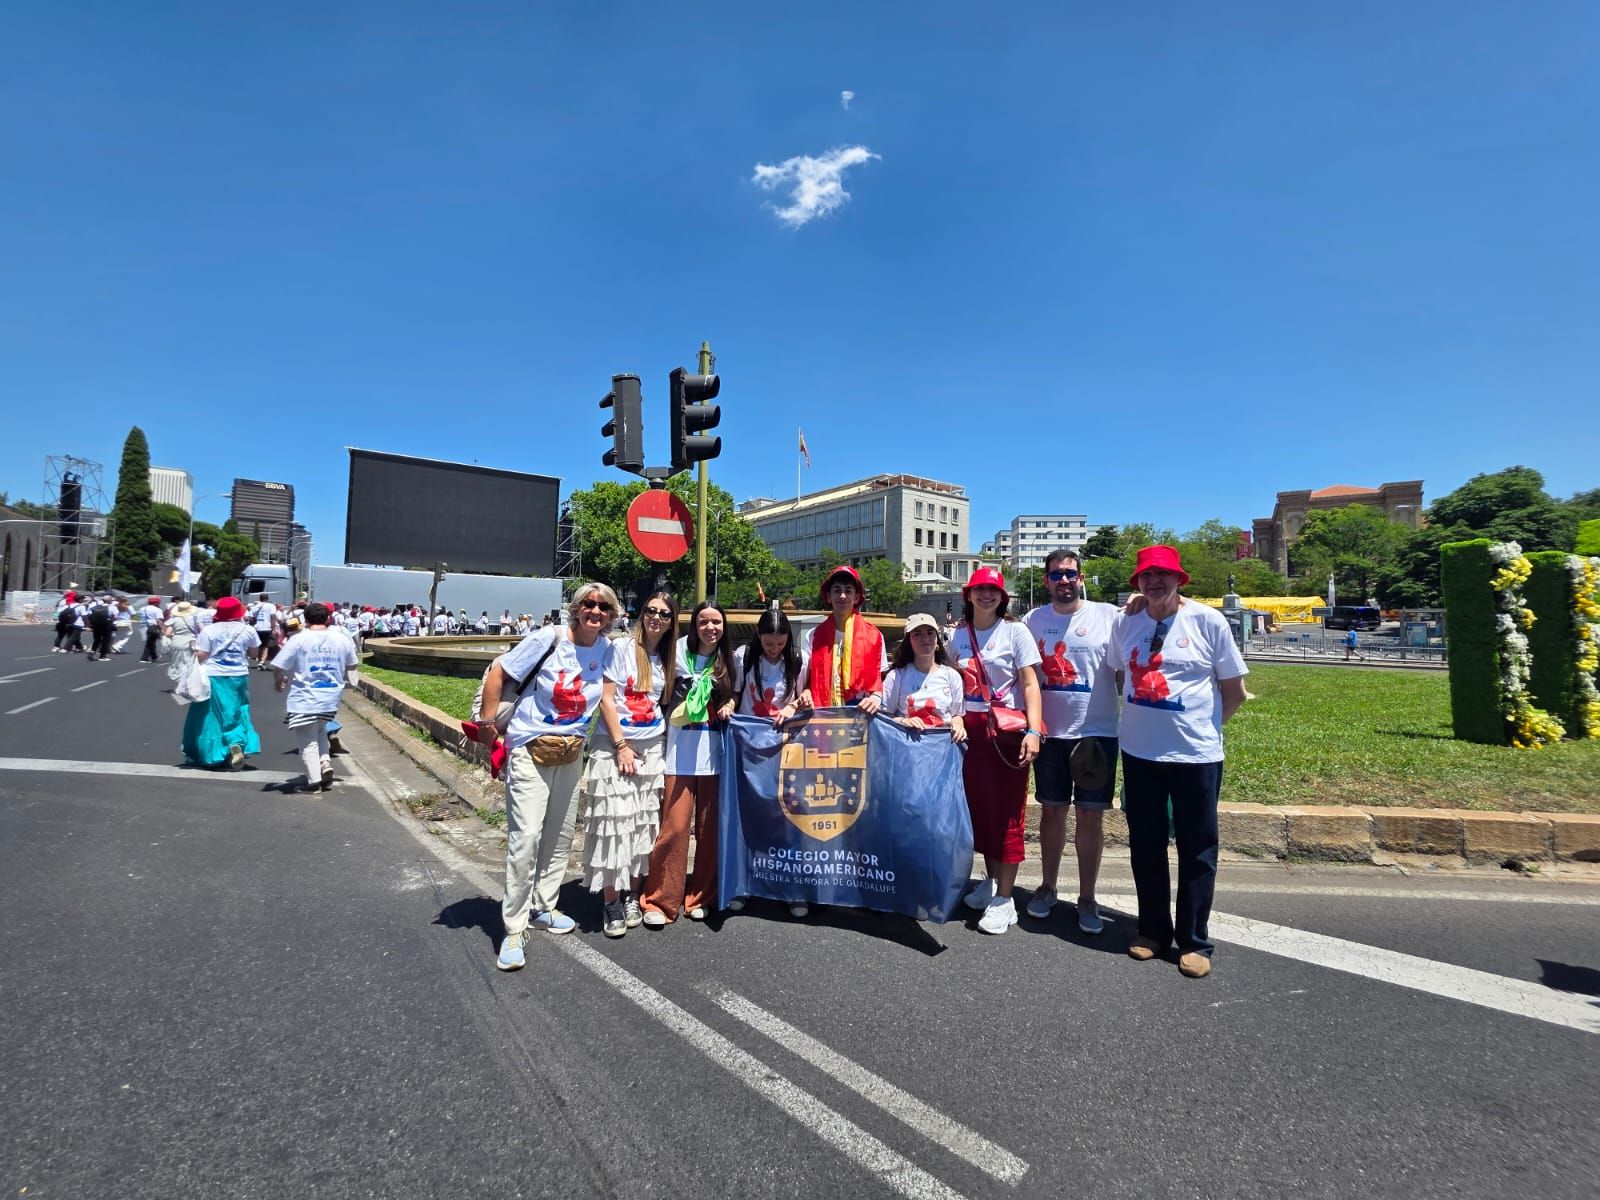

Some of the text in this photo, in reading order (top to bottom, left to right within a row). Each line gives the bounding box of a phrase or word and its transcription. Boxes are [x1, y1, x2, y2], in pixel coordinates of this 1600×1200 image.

[265, 482, 286, 490] BBVA
[812, 820, 837, 831] 1951
[768, 846, 879, 866] COLEGIO MAYOR
[753, 857, 896, 882] HISPANOAMERICANO
[753, 870, 790, 883] NUESTRA
[833, 877, 844, 886] DE
[847, 878, 896, 894] GUADALUPE
